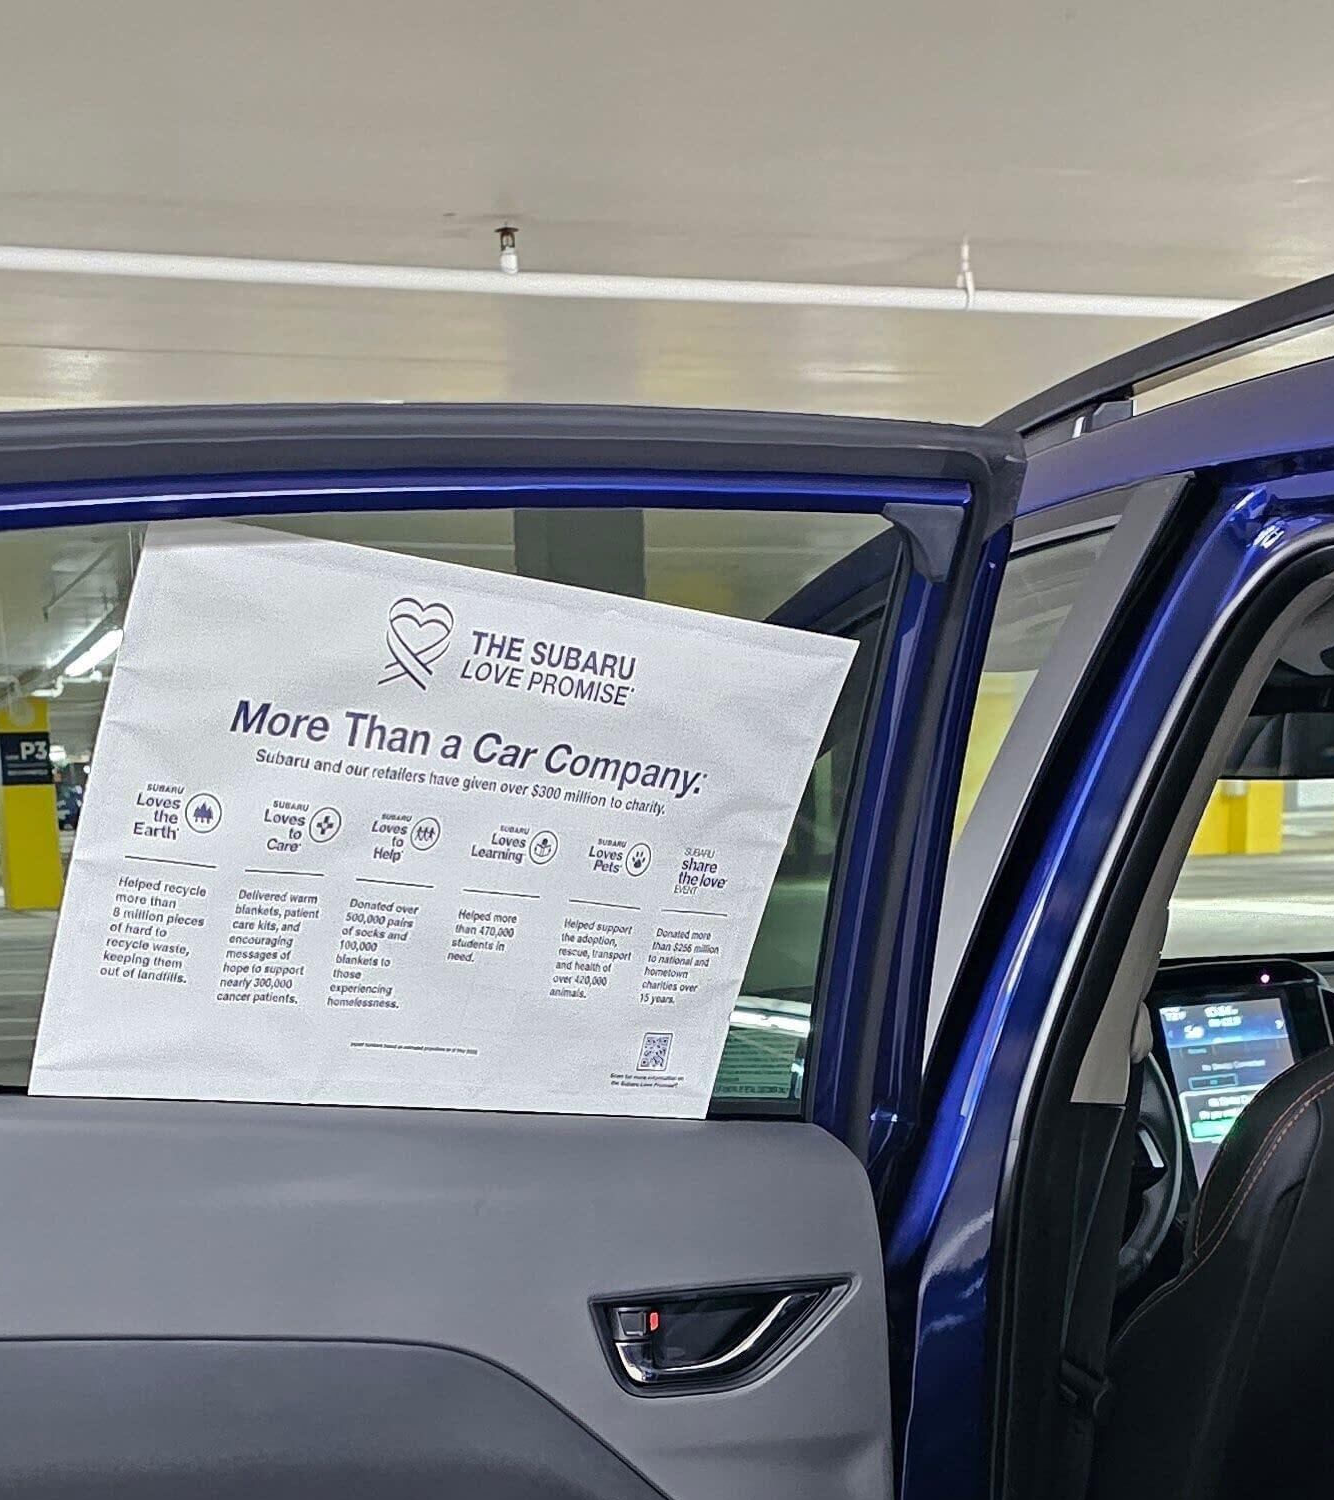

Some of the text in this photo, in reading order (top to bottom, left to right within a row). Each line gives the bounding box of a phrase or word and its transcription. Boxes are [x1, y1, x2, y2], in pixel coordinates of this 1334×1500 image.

[471, 630, 636, 680] THE SUBARU
[460, 659, 522, 688] LOVE
[229, 700, 330, 742] More
[345, 712, 432, 756] Than
[440, 734, 461, 759] a
[472, 732, 538, 770] Car
[20, 741, 46, 760] P3
[147, 783, 185, 795] SUBARU
[256, 749, 666, 817] Subaru and our retailers have given over $300 million to charity.
[136, 792, 181, 809] Loves
[273, 800, 309, 812] SUBARU
[154, 810, 178, 824] the
[264, 809, 306, 826] Loves
[133, 822, 179, 840] Earth
[288, 828, 302, 840] to
[371, 821, 408, 835] Loves
[266, 838, 301, 852] Care
[392, 837, 404, 848] to
[491, 834, 526, 848] Loves
[373, 848, 404, 862] Help
[471, 846, 524, 864] Learning
[589, 846, 623, 860] Loves
[684, 848, 715, 858] SUBARU
[593, 859, 622, 873] Pets
[681, 858, 717, 873] share
[678, 872, 699, 886] the
[118, 877, 206, 897] Helped recycle
[674, 886, 699, 895] EVENT
[115, 893, 176, 909] more than
[238, 889, 318, 904] Delivered warm
[235, 904, 319, 919] blankets, patient
[349, 899, 419, 915] Donated over
[112, 907, 205, 927] 8 million pieces
[345, 912, 413, 929] 500,000 pairs
[458, 909, 517, 923] Helped more
[110, 923, 167, 937] of hard to
[232, 920, 301, 932] care kits, and
[455, 924, 514, 938] than 470,000
[564, 918, 632, 935] Helped support
[342, 926, 408, 941] of socks and
[562, 934, 617, 947] the adoption,
[656, 928, 711, 940] Donated more
[106, 937, 190, 957] recycle waste,
[229, 936, 293, 948] encouraging
[340, 939, 377, 952] 100,000
[451, 938, 505, 951] students in
[652, 942, 671, 951] than
[694, 945, 719, 954] million
[103, 951, 182, 969] keeping them
[226, 949, 291, 961] messages of
[335, 954, 391, 967] blankets to
[447, 951, 475, 962] need.
[559, 948, 631, 961] rescue, transport
[648, 954, 709, 967] to national and
[222, 963, 304, 976] hope to support
[556, 961, 612, 972] and health of
[645, 967, 688, 978] hometown
[100, 966, 187, 984] out of landfills.
[333, 969, 361, 979] those
[553, 976, 607, 986] over 420,000
[220, 978, 292, 990] nearly 300,000
[330, 983, 392, 996] experiencing
[642, 980, 698, 992] charities over
[217, 993, 298, 1004] cancer patients.
[550, 989, 586, 998] animals.
[640, 994, 675, 1005] 15 years.
[327, 997, 399, 1009] homelessness.
